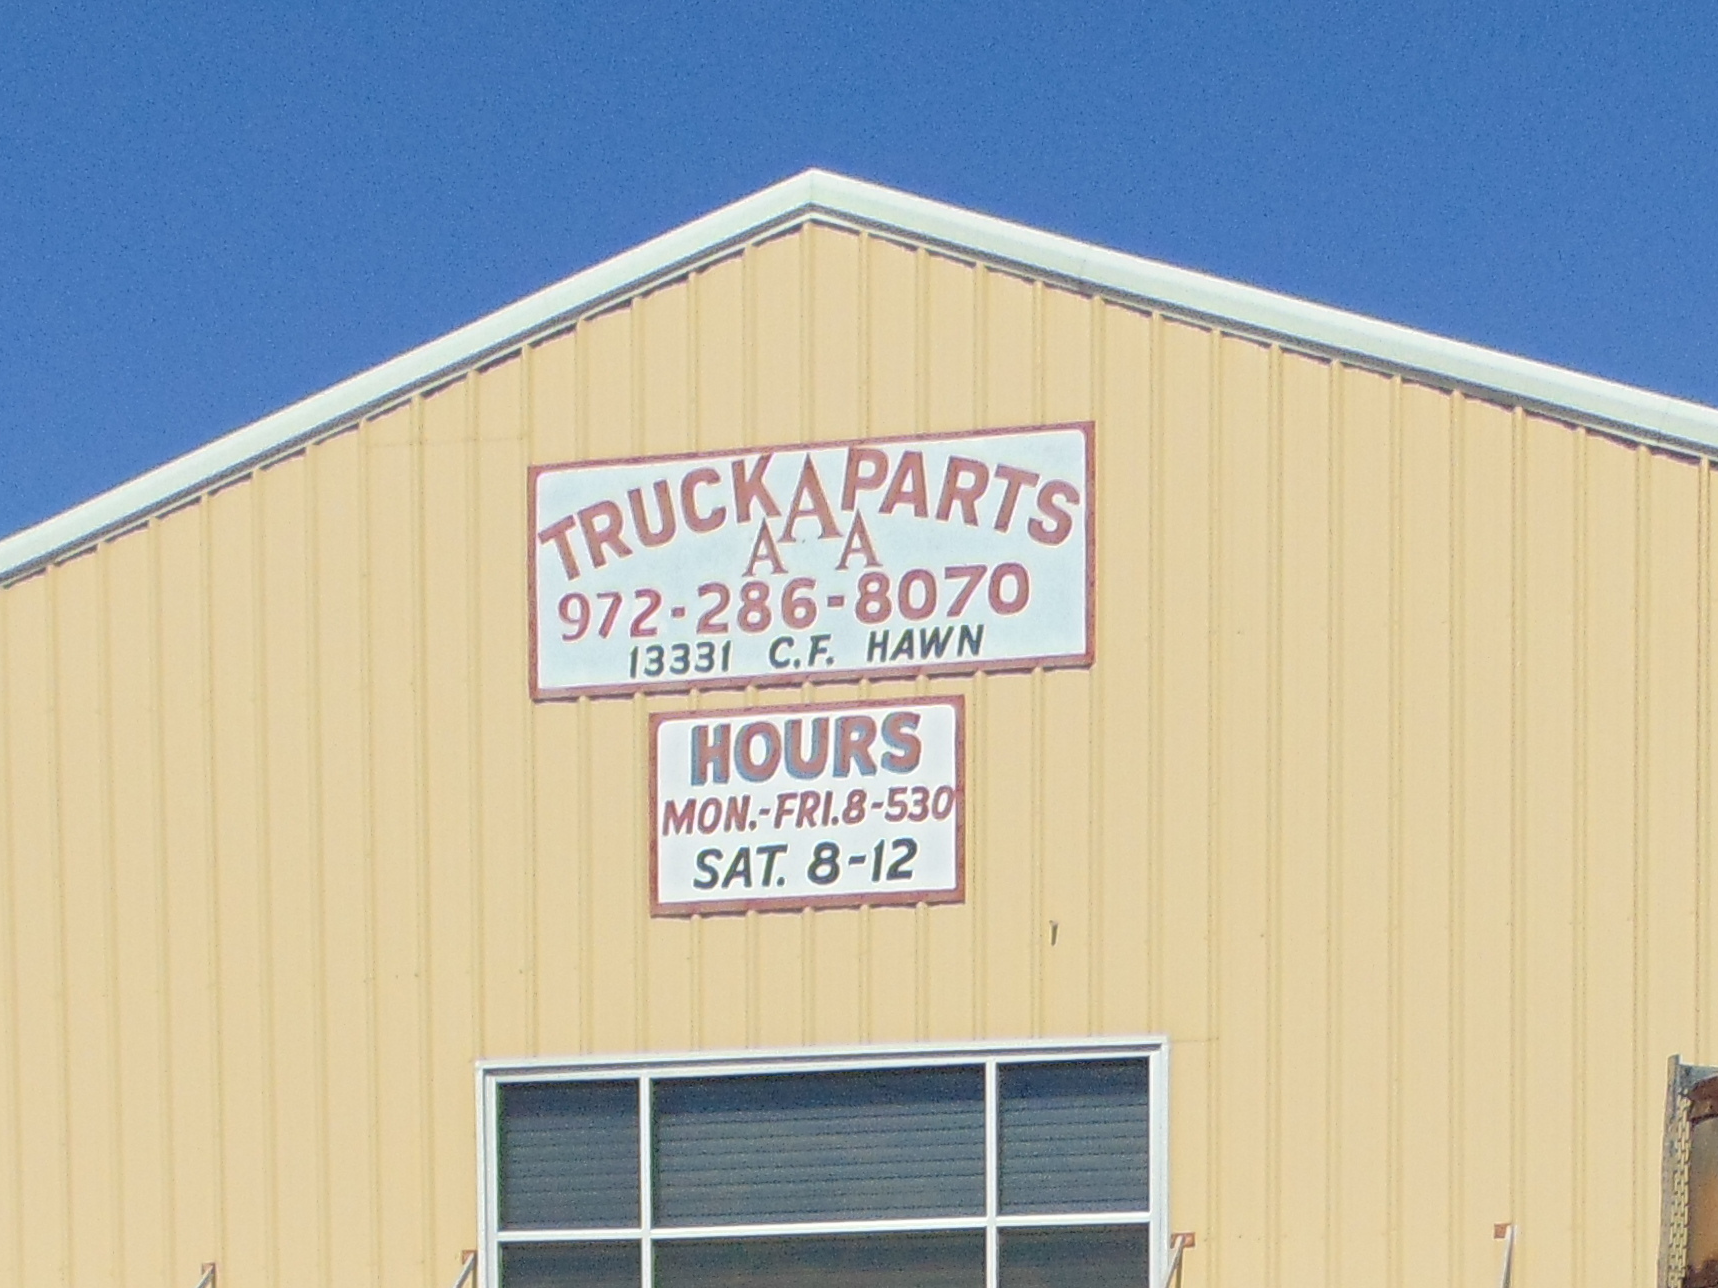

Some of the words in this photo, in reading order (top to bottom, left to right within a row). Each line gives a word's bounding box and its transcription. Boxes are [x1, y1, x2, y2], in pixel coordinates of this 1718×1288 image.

[538, 453, 782, 581] TRUCK
[841, 447, 1080, 546] PARTS
[558, 562, 1029, 641] 972-286-8070
[629, 640, 731, 680] 13331
[769, 634, 834, 669] C.F.
[867, 624, 985, 663] HAWN
[690, 711, 922, 786] HOURS
[692, 843, 788, 890] SAT.
[807, 837, 918, 886] 8-12
